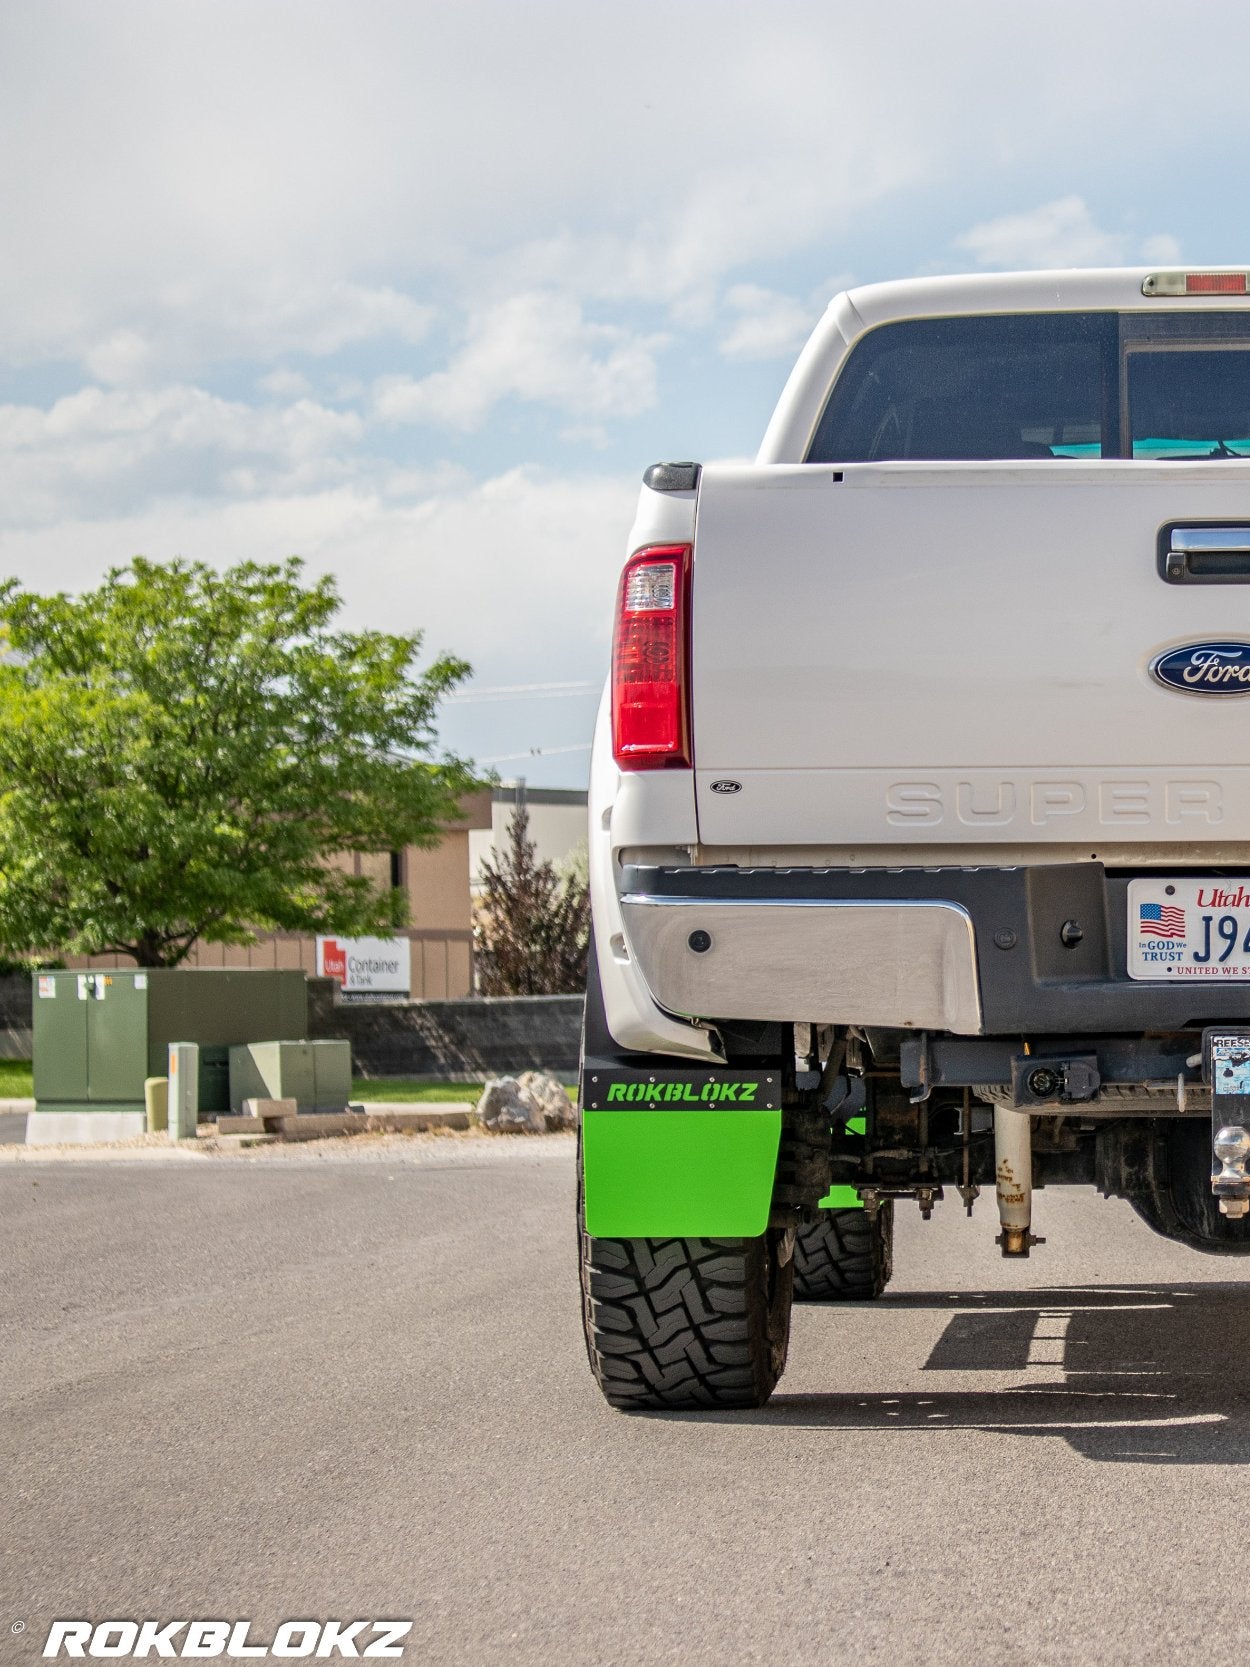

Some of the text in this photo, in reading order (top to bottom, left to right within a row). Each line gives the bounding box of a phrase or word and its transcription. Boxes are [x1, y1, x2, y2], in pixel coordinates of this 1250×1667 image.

[885, 780, 1224, 827] SUPER
[1196, 886, 1250, 908] Utah
[1147, 940, 1175, 951] GOD
[1142, 951, 1183, 962] TRUST
[324, 960, 344, 973] Utah
[348, 956, 400, 974] Container
[1177, 966, 1219, 975] UNITED
[1222, 966, 1239, 975] WE
[1217, 1039, 1250, 1048] REESE
[607, 1083, 758, 1102] ROKBLOKZ
